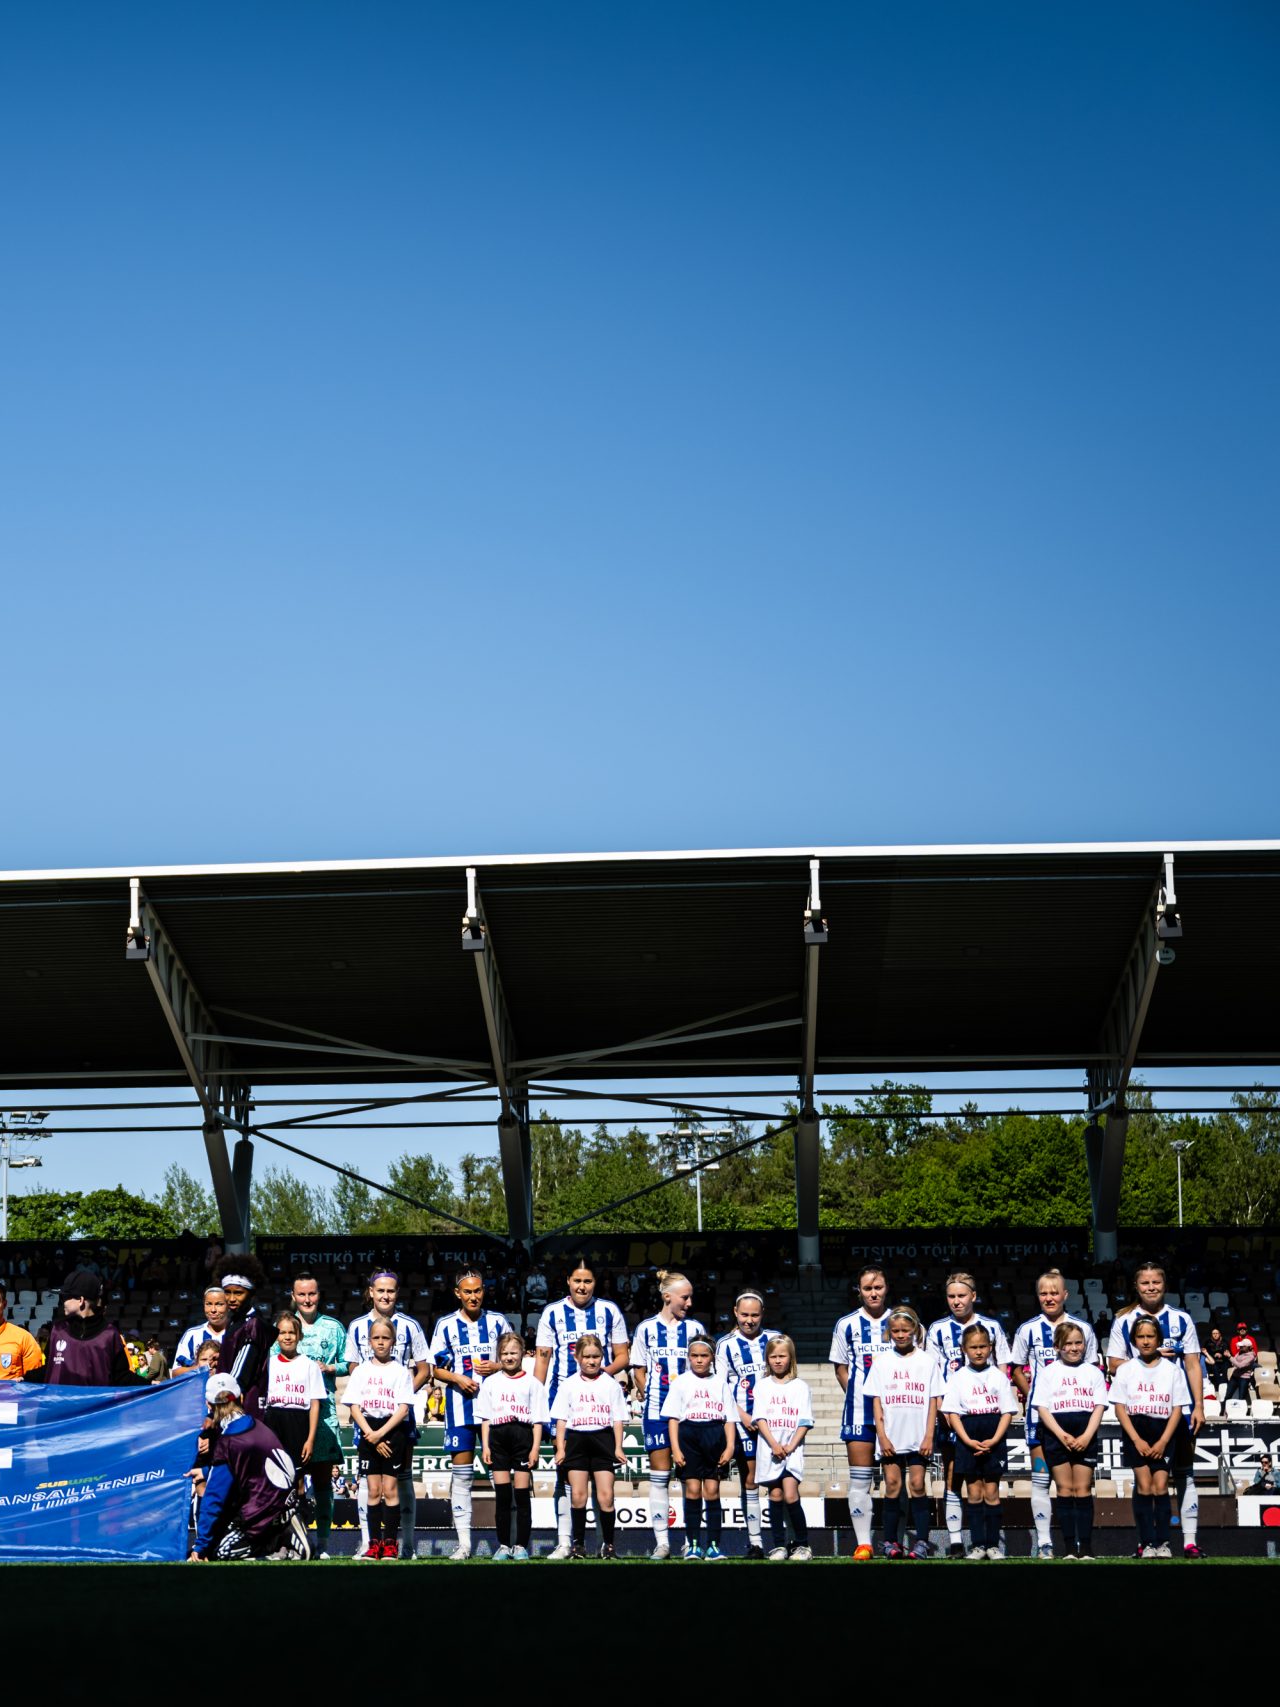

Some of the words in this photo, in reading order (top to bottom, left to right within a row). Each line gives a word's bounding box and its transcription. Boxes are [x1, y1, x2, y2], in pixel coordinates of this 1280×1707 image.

[626, 1240, 707, 1267] BOLT
[850, 1242, 918, 1259] ETSITKÖ
[920, 1241, 969, 1258] TÖITÄ
[974, 1242, 999, 1257] TAI
[289, 1249, 353, 1265] ETSITKÖ
[455, 1344, 492, 1355] HCLTech
[652, 1347, 689, 1357] HCLTech
[285, 1384, 305, 1394] RIKO
[905, 1381, 925, 1393] RIKO
[1074, 1387, 1095, 1397] RIKO
[885, 1394, 925, 1406] URHEILUA
[1149, 1393, 1170, 1403] RIKO
[591, 1404, 611, 1414] RIKO
[1053, 1399, 1096, 1411] URHEILUA
[1126, 1405, 1170, 1416] URHEILUA
[851, 1424, 863, 1436] 18
[452, 1436, 459, 1447] 8
[653, 1432, 665, 1446] 14
[742, 1439, 753, 1453] 16
[361, 1459, 369, 1470] 27
[35, 1474, 108, 1490] SUBWAY
